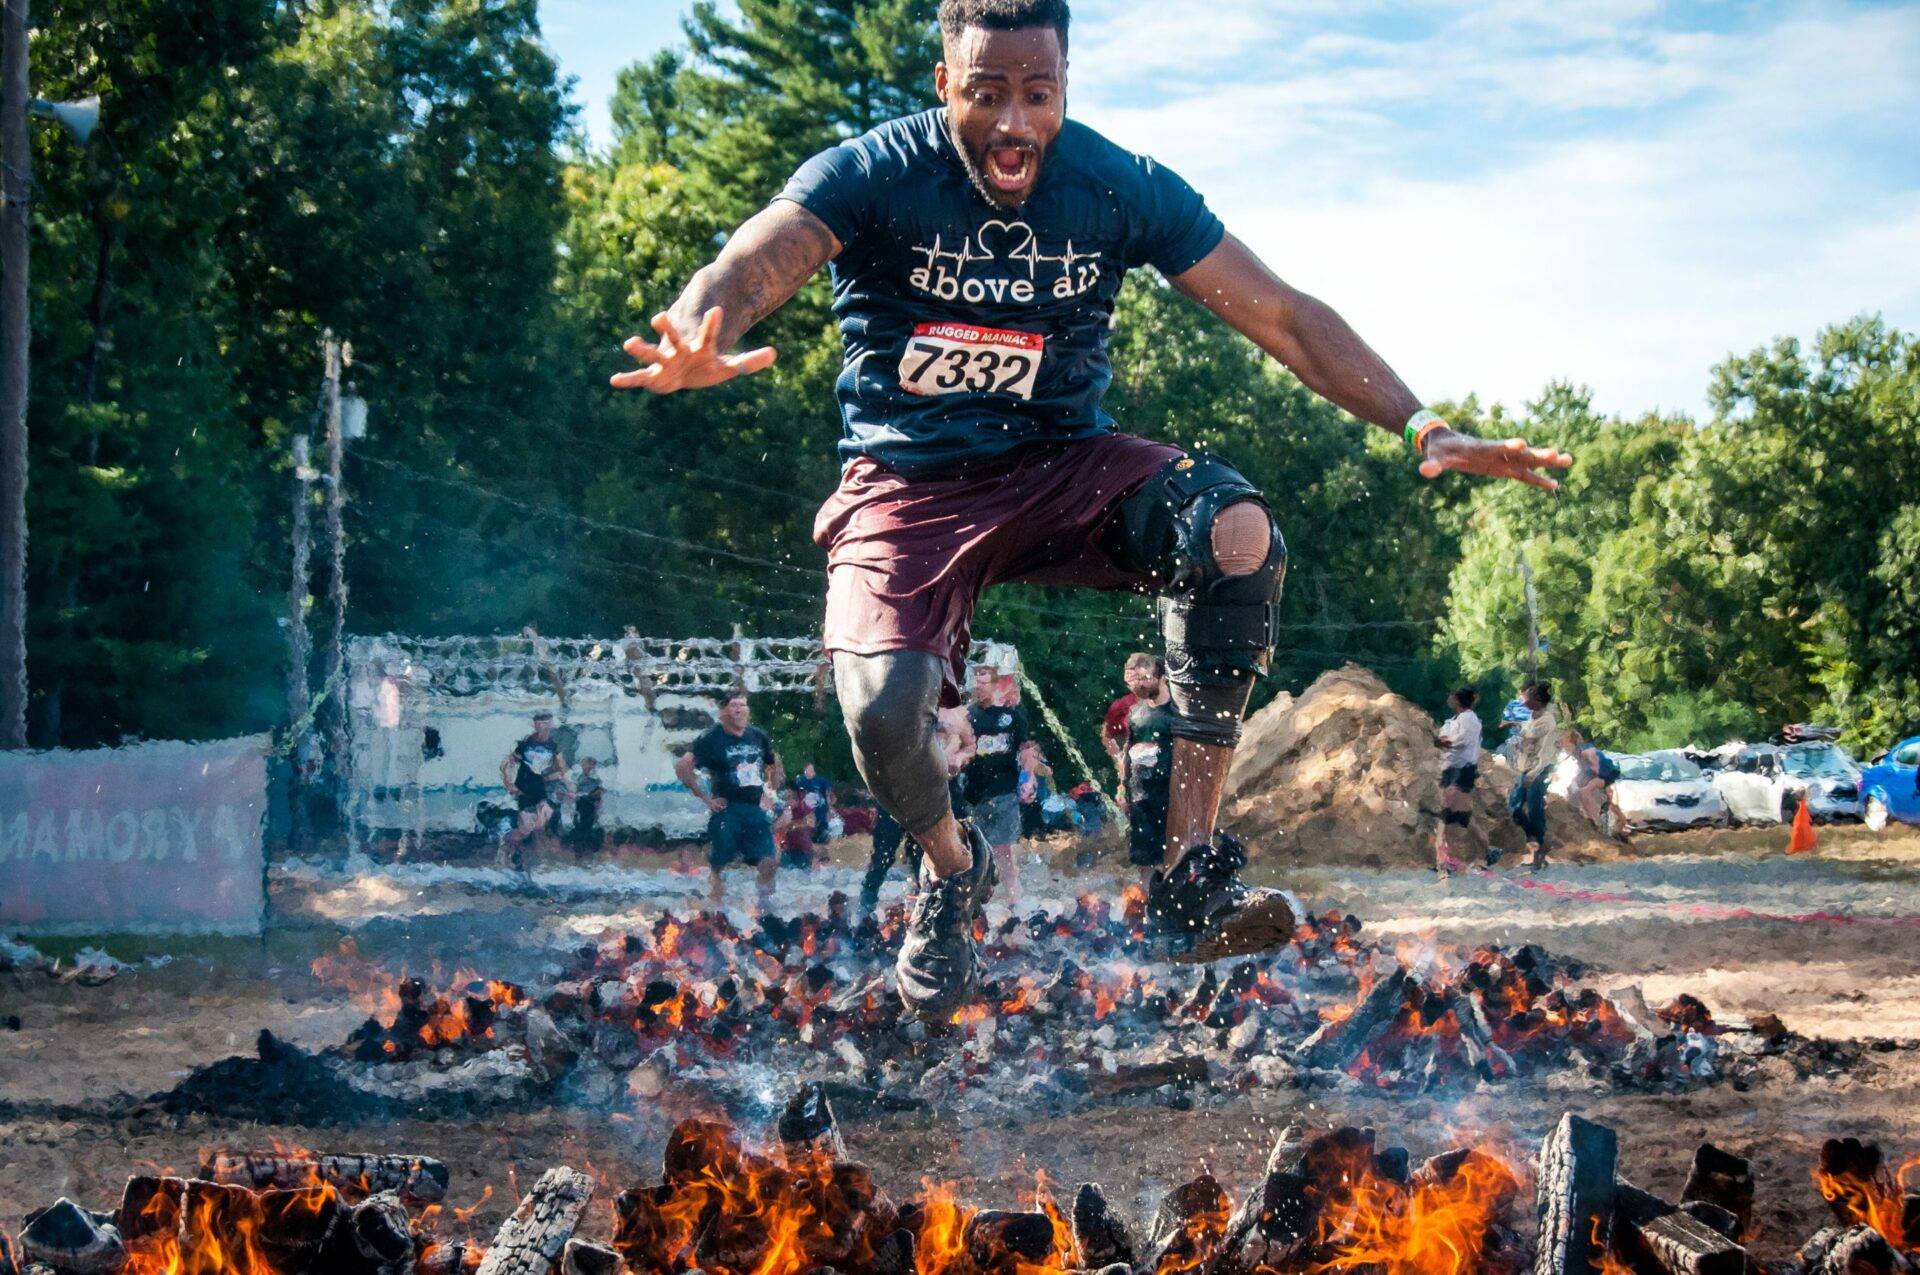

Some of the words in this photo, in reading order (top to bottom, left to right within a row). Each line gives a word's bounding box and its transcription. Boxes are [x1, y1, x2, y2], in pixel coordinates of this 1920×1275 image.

[909, 266, 1034, 303] above
[928, 326, 979, 341] RUGGED
[981, 332, 1028, 346] MANIAC
[908, 342, 1031, 398] 7332
